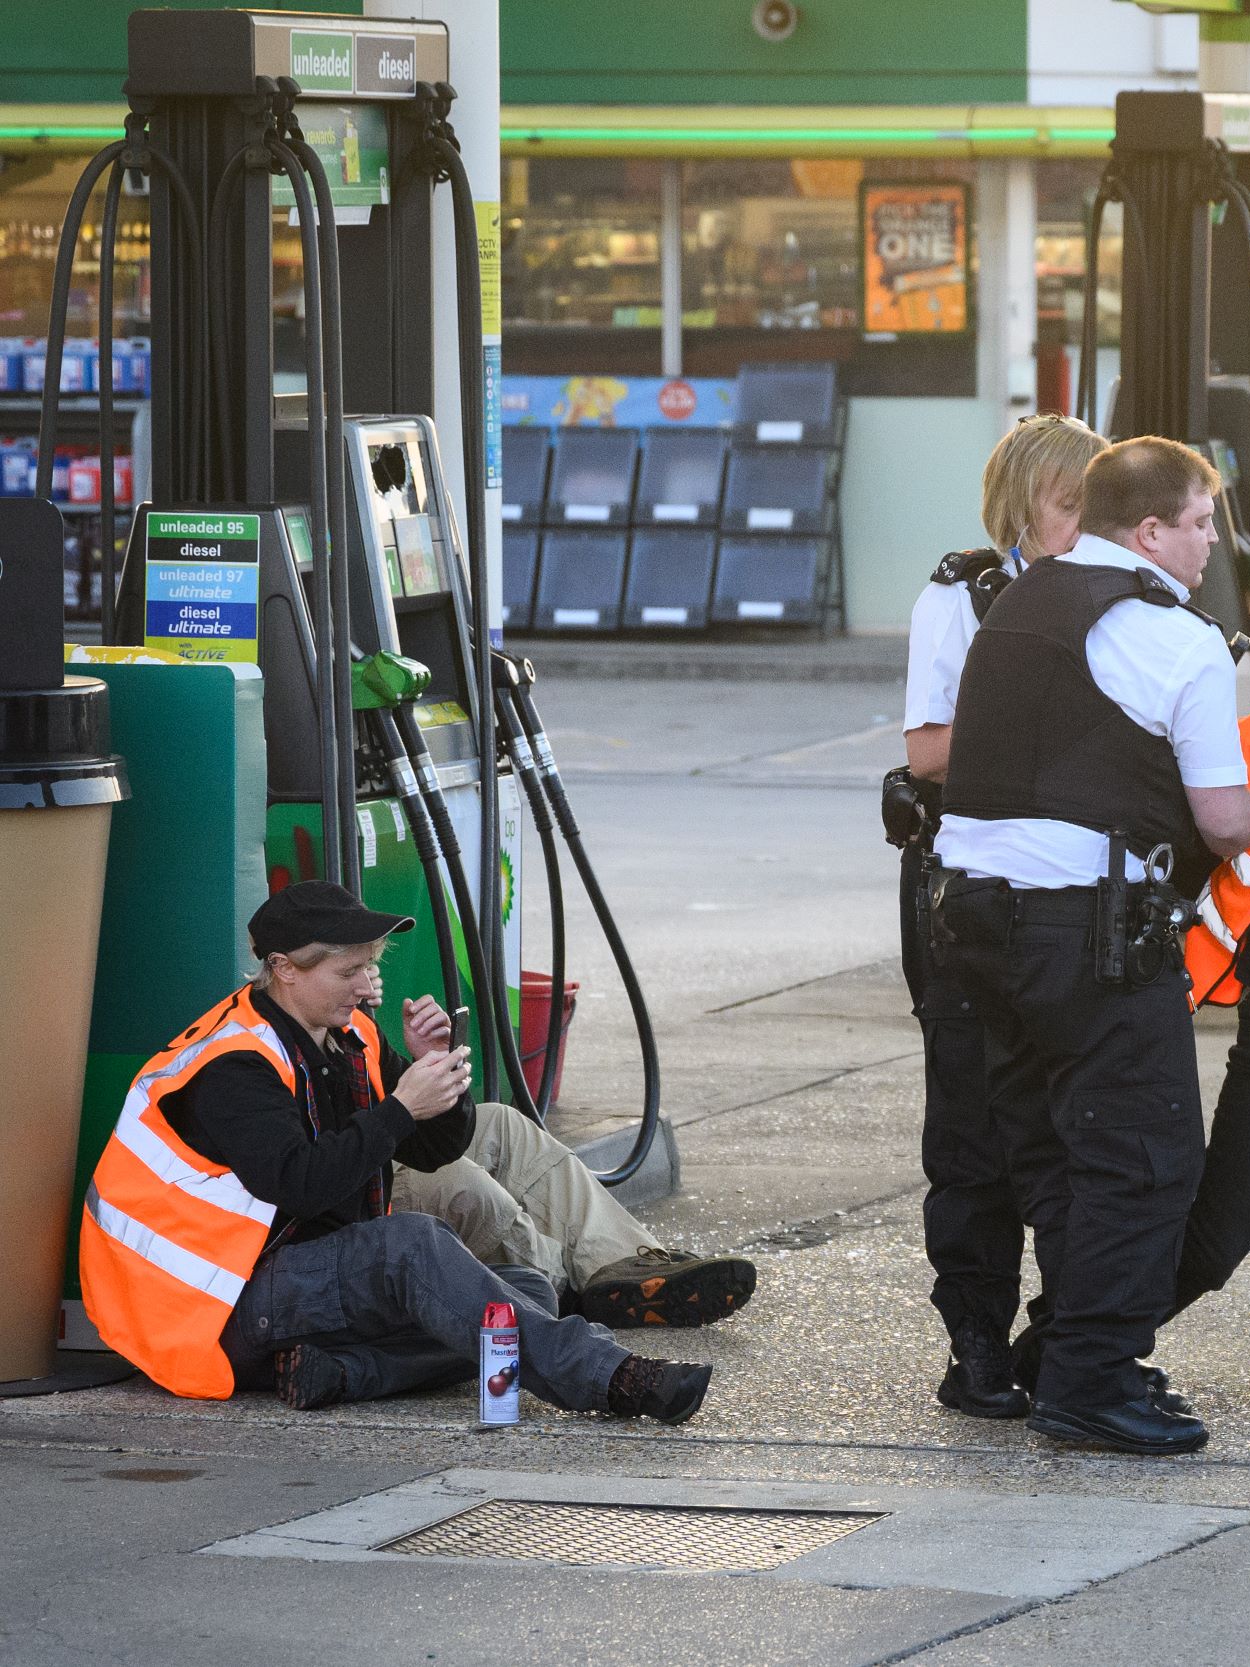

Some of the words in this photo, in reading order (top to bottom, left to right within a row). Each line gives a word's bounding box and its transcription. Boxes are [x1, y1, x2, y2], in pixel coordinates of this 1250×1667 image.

[293, 47, 350, 78] unleaded
[378, 50, 414, 80] diesel
[878, 232, 954, 262] ONE
[160, 520, 223, 534] unleaded
[227, 522, 245, 534] 95
[180, 543, 221, 557] diesel
[159, 568, 223, 582] unleaded
[226, 570, 244, 582] 97
[169, 585, 233, 599] ultimate
[179, 606, 221, 619] diesel
[168, 620, 233, 635] ultimate
[178, 649, 229, 660] ACTIVE
[505, 816, 516, 844] bp
